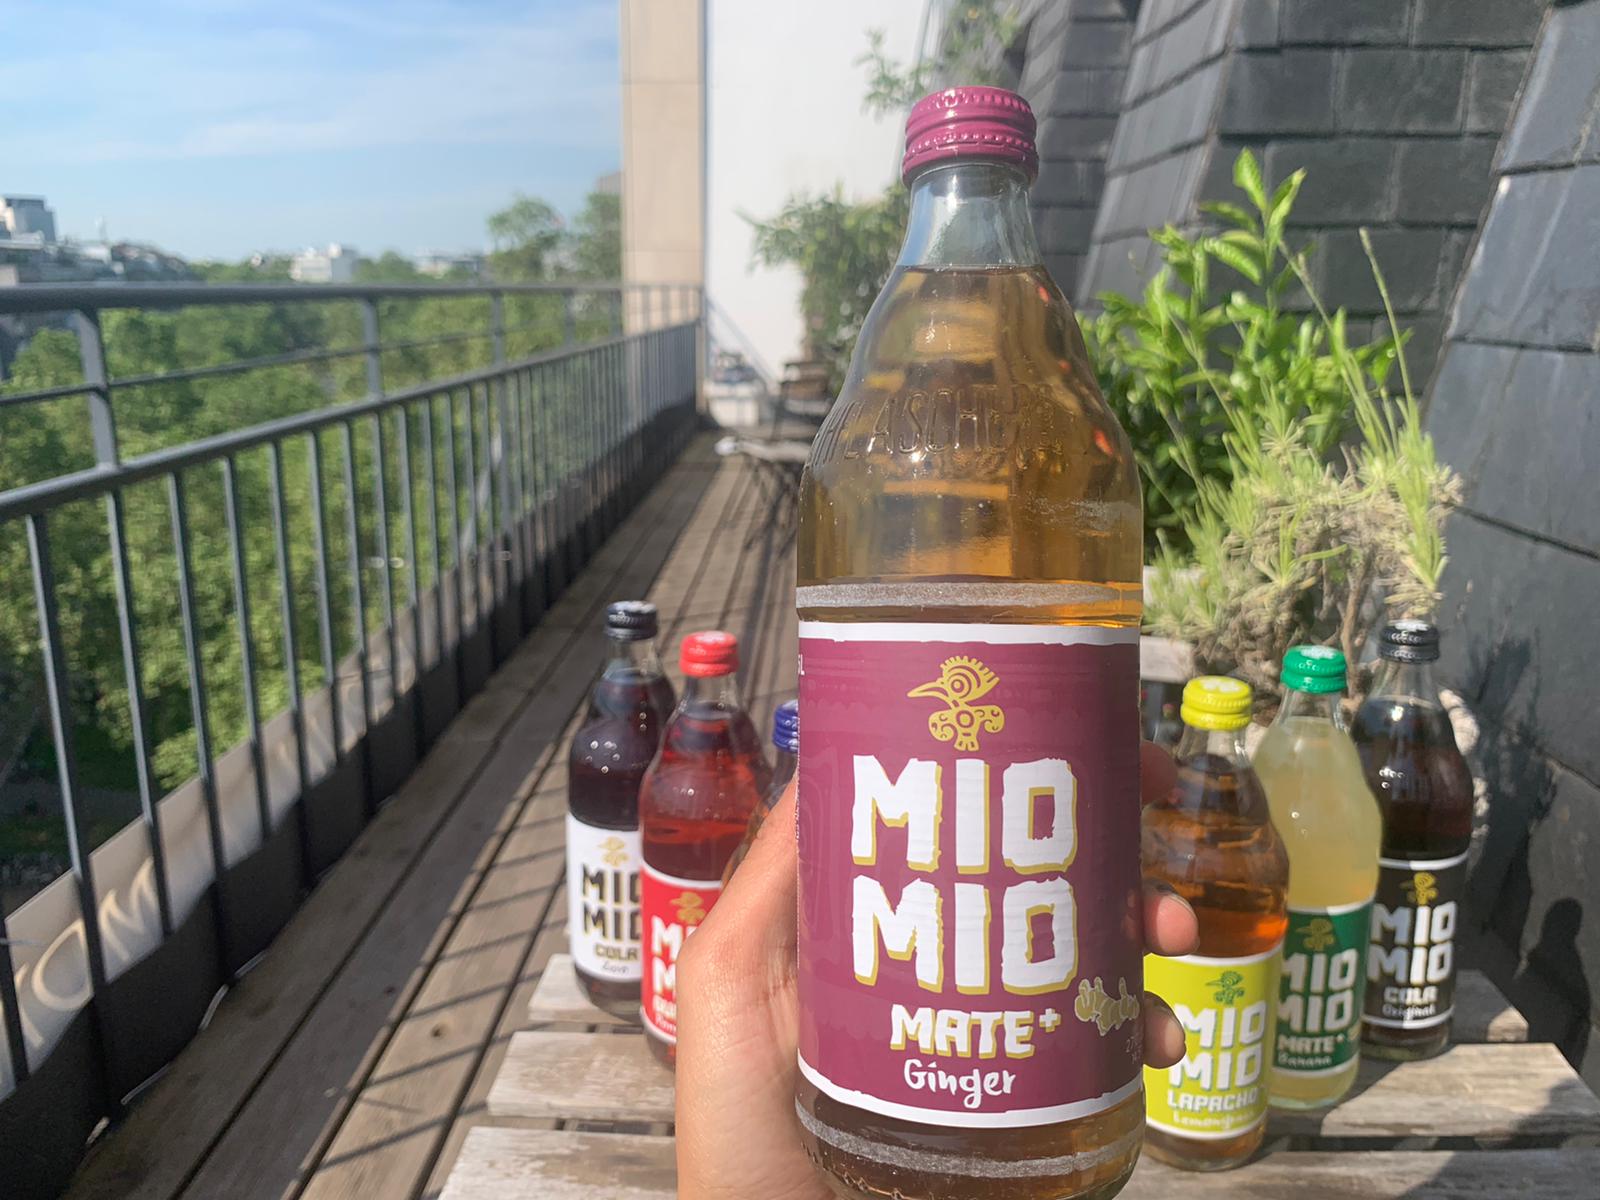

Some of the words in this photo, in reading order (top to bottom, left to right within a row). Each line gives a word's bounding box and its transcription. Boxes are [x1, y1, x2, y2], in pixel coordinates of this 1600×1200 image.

[851, 755, 1078, 875] MIO
[852, 874, 1078, 995] MIO
[1370, 901, 1457, 945] MIO
[595, 943, 639, 962] COLA
[1367, 941, 1453, 985] MIO
[1383, 986, 1438, 1005] COLA
[904, 1059, 1017, 1108] Ginger
[1168, 1042, 1263, 1091] MIO
[1167, 1087, 1259, 1114] LAPACHO
